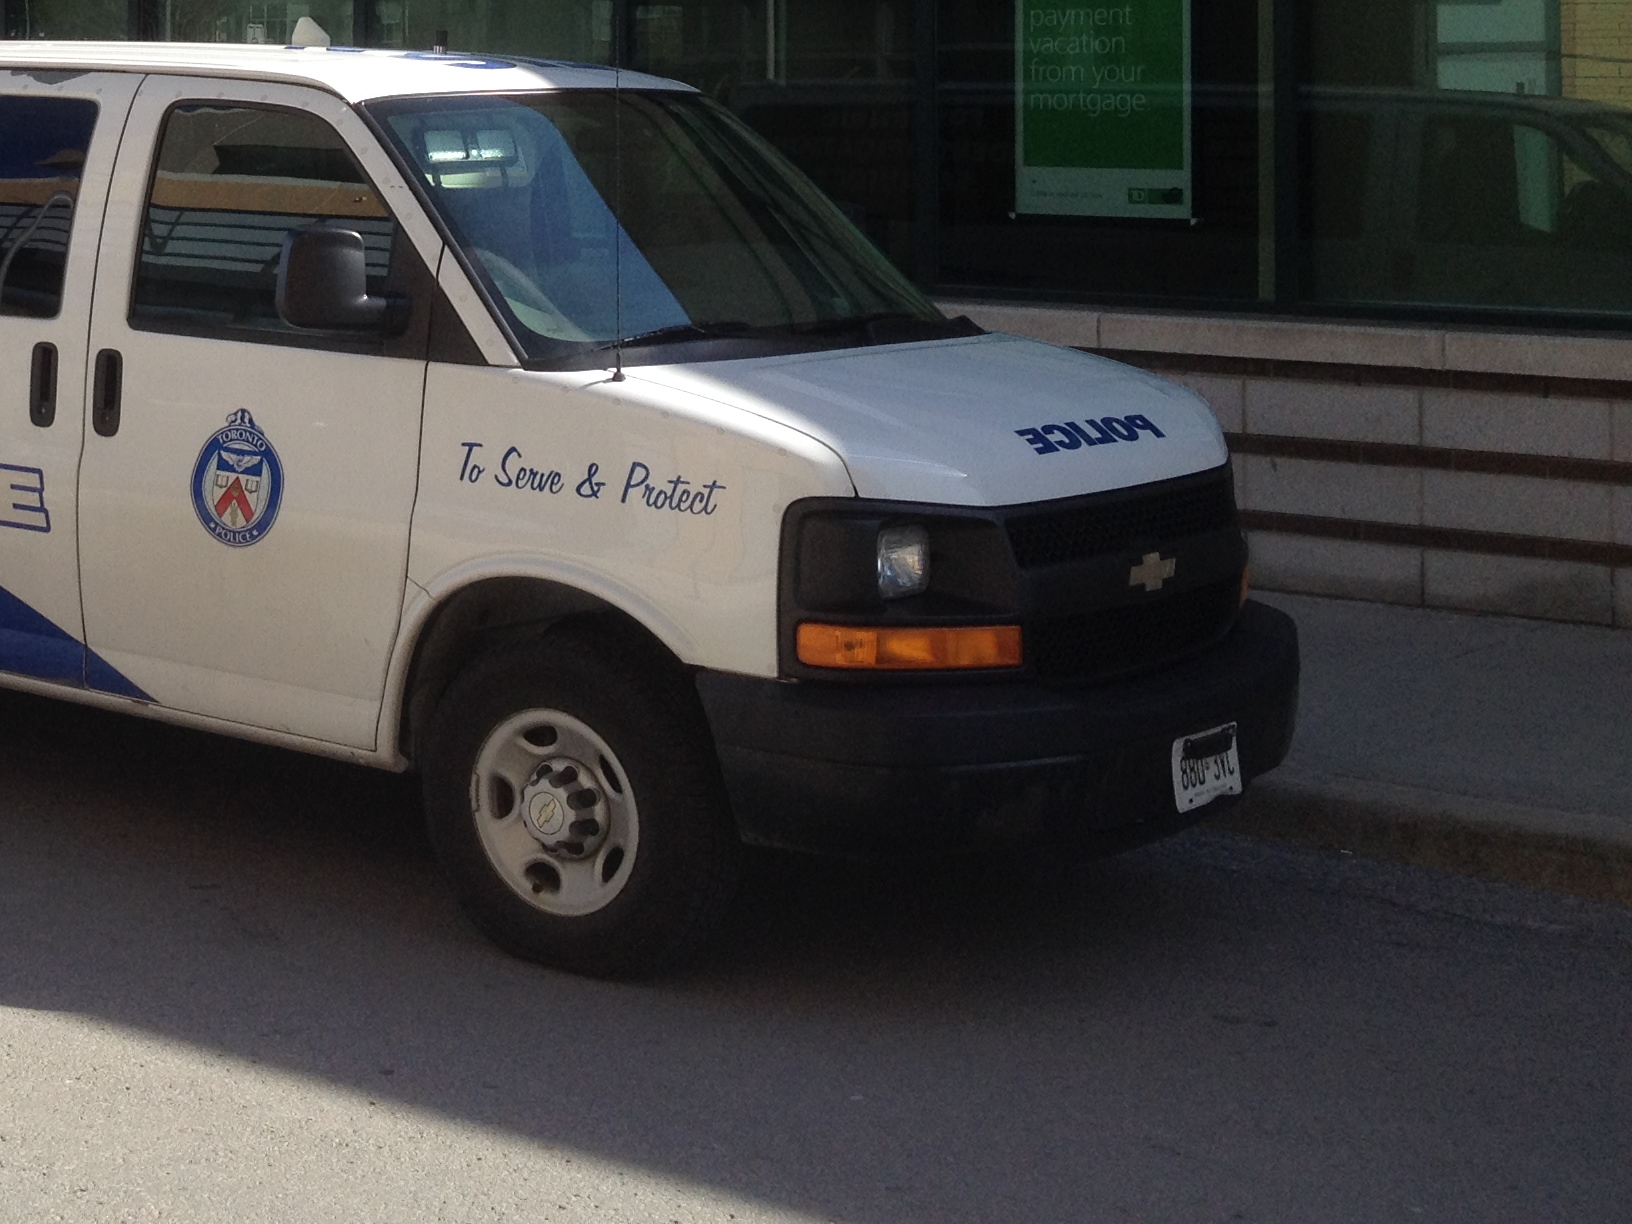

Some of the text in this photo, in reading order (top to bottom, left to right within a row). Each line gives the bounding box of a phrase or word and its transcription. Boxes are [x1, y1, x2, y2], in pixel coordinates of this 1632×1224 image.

[1030, 5, 1133, 31] payment
[1029, 30, 1126, 55] vacation
[1030, 58, 1145, 88] from your
[217, 429, 267, 452] TORONTO
[459, 441, 727, 518] To Serve & Protect
[215, 526, 252, 544] POLICE
